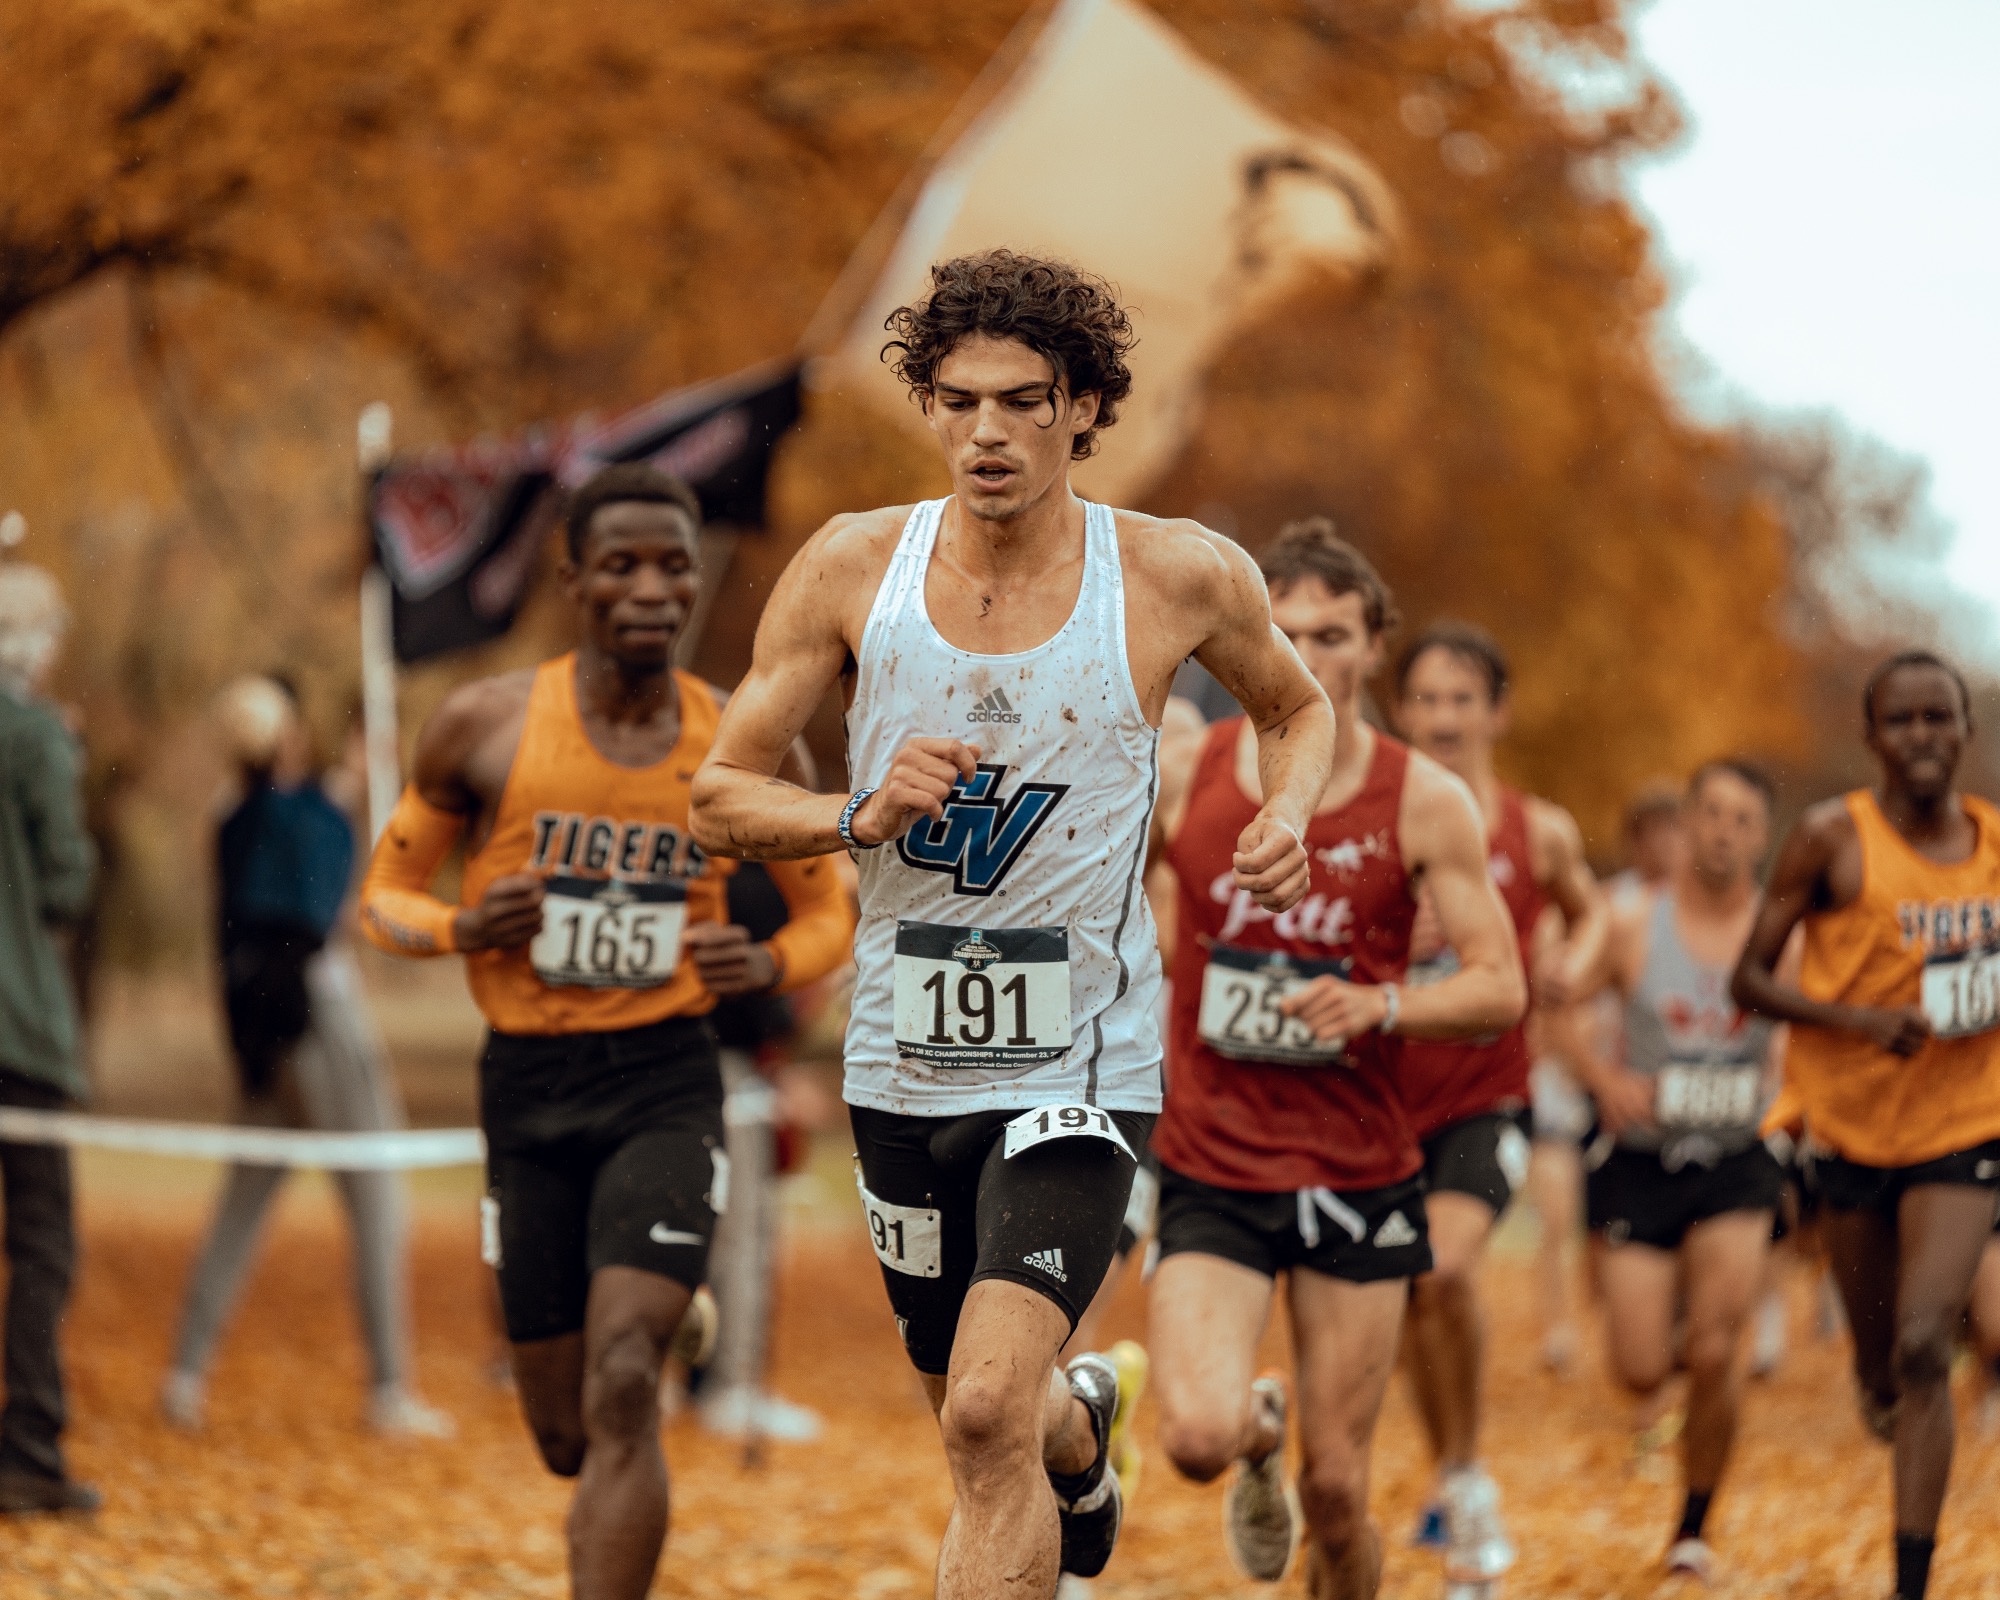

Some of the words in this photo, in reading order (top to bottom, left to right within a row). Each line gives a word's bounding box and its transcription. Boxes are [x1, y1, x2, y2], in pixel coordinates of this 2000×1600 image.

[966, 709, 1021, 724] adidas
[896, 762, 1071, 897] GV
[561, 911, 656, 976] 165
[953, 950, 1000, 960] CHAMPIONSHIPS
[922, 970, 1036, 1046] 191
[934, 1050, 994, 1058] CHAMPIONSHIPS
[1033, 1107, 1109, 1135] 191
[866, 1206, 904, 1260] 91
[1023, 1255, 1067, 1283] adidas
